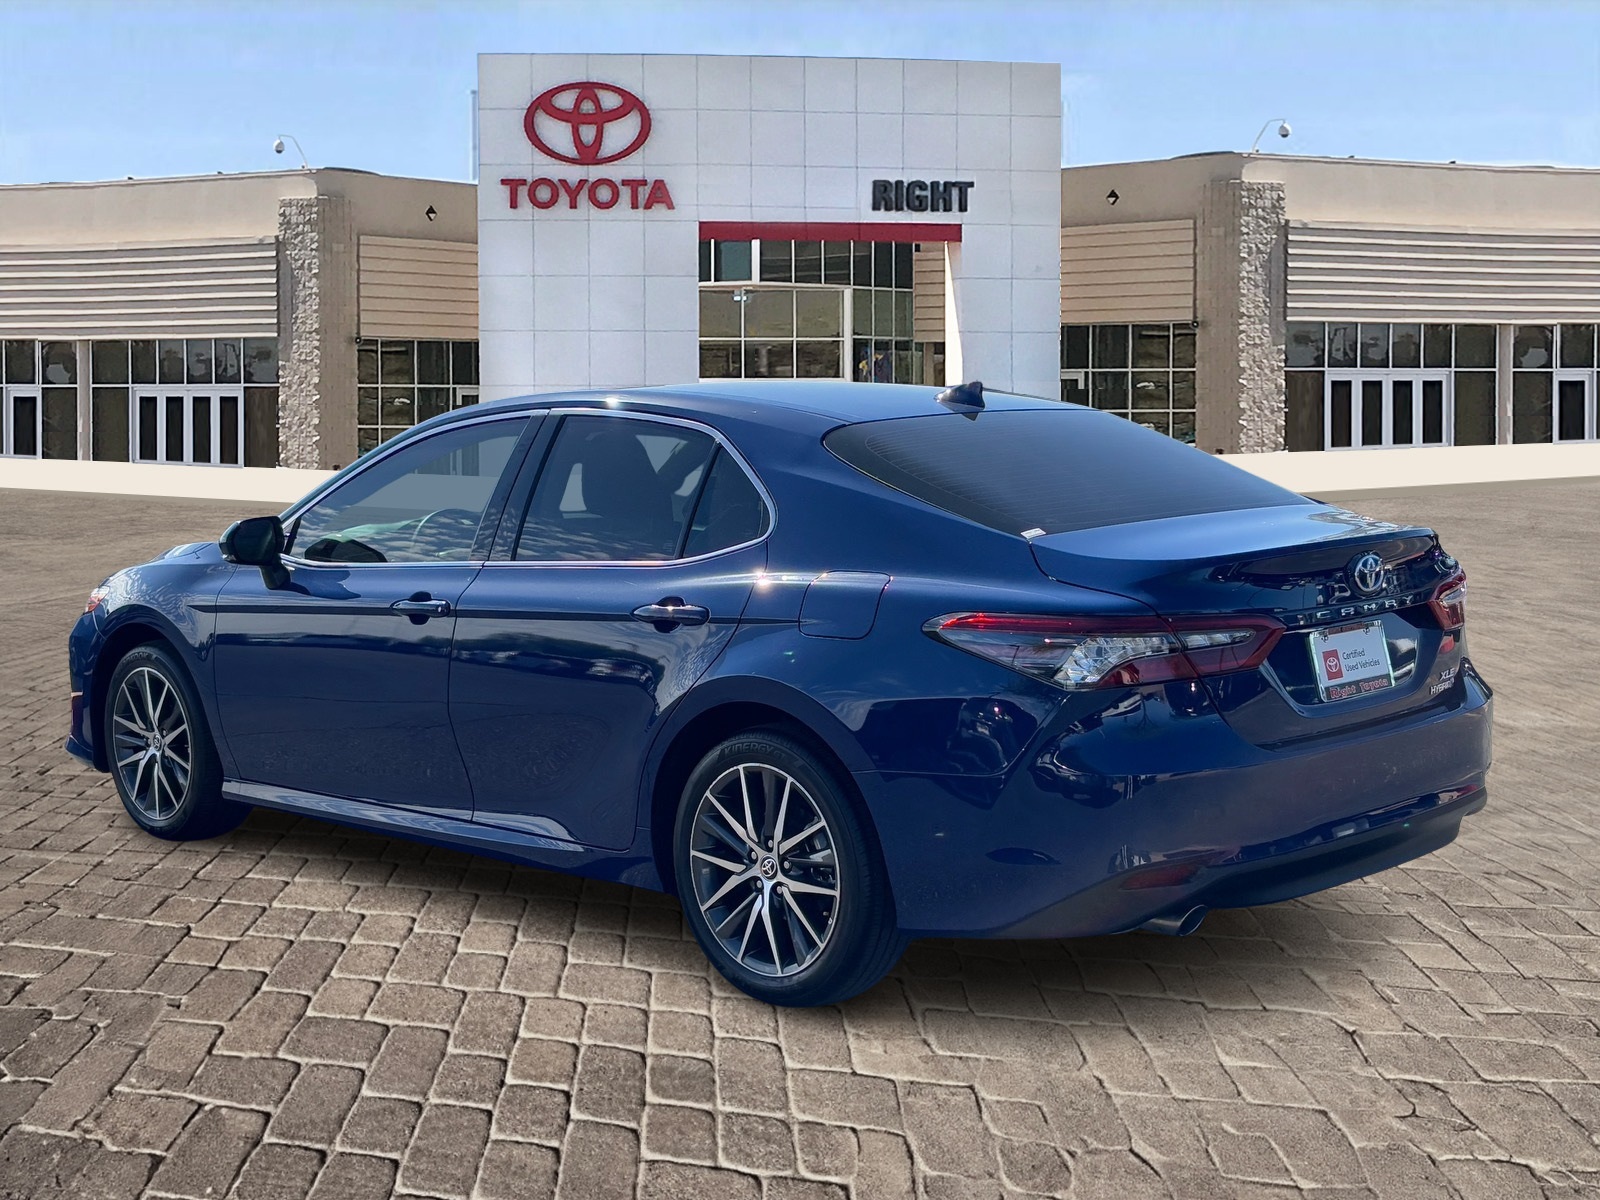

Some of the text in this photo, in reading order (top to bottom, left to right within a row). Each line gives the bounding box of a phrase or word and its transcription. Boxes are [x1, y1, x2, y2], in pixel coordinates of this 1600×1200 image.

[500, 178, 675, 210] TOYOTA
[872, 179, 975, 212] RIGHT
[1316, 595, 1414, 619] CAMRY
[1342, 648, 1365, 660] Certified
[1345, 658, 1380, 672] Used Vehicles
[1440, 667, 1455, 681] XLE
[1330, 678, 1388, 698] Right Toyota
